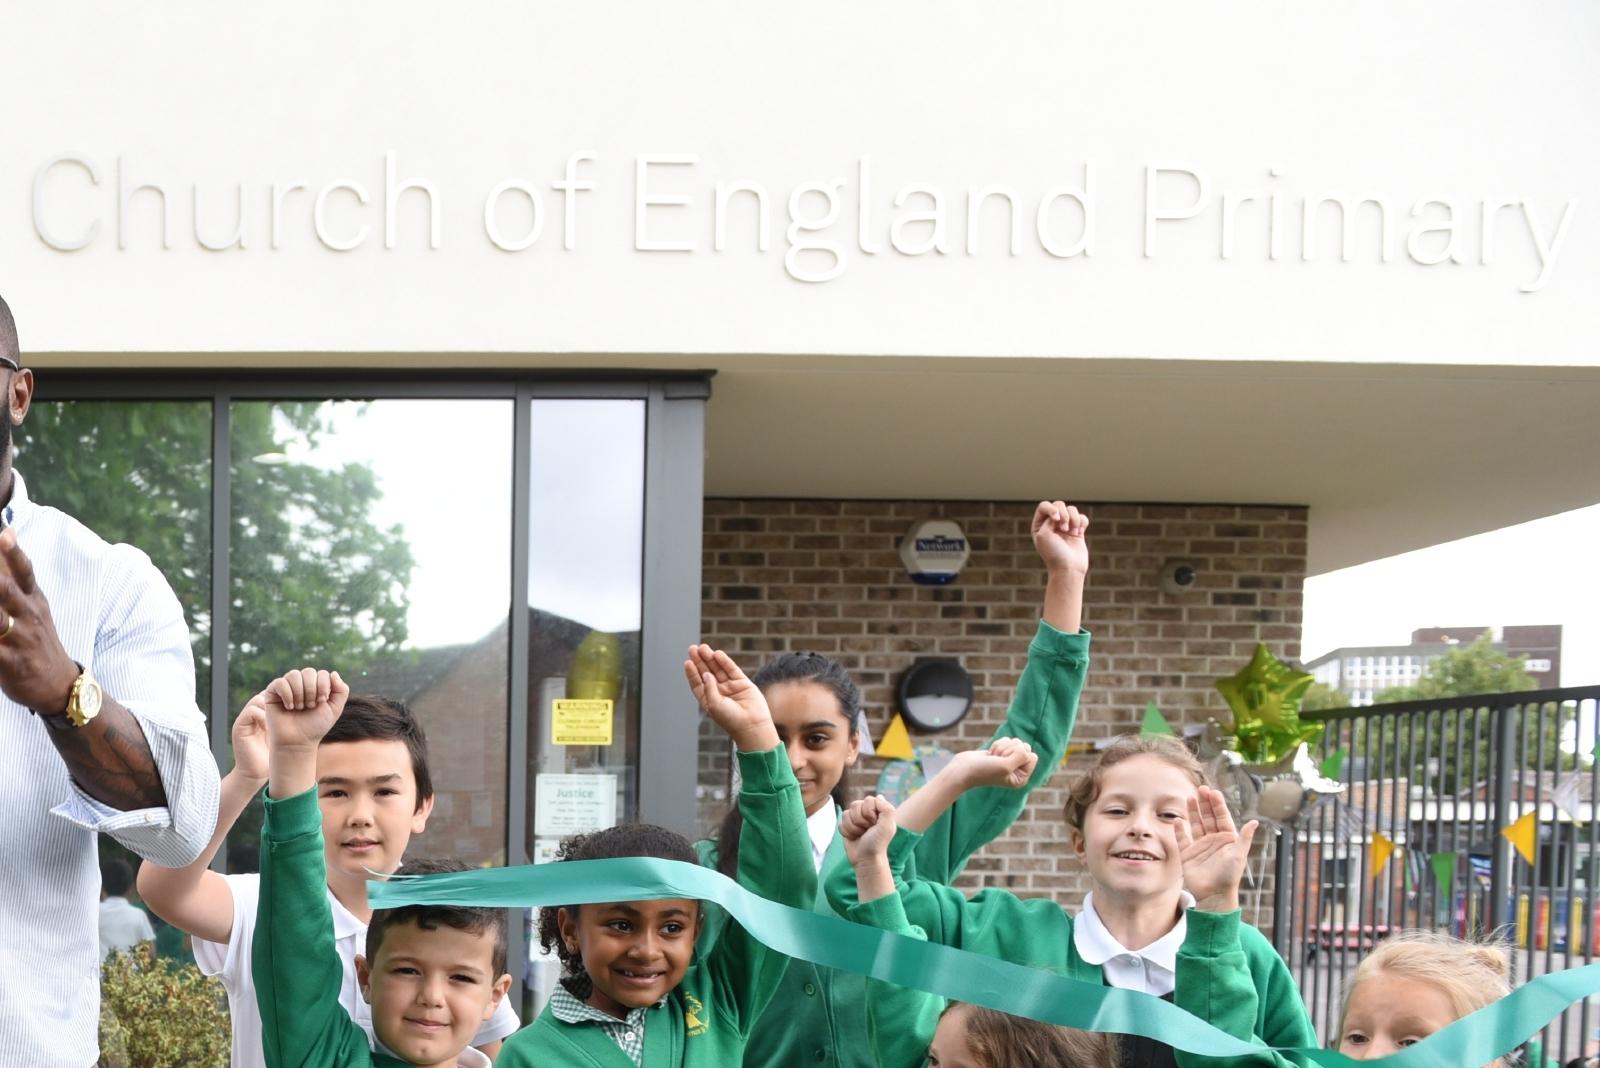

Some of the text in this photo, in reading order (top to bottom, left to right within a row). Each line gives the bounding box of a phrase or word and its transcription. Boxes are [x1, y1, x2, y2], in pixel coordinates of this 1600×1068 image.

[31, 149, 444, 252] Church
[482, 149, 599, 253] of
[634, 154, 1097, 282] England
[1143, 161, 1577, 293] Primary
[556, 788, 595, 799] Justice
